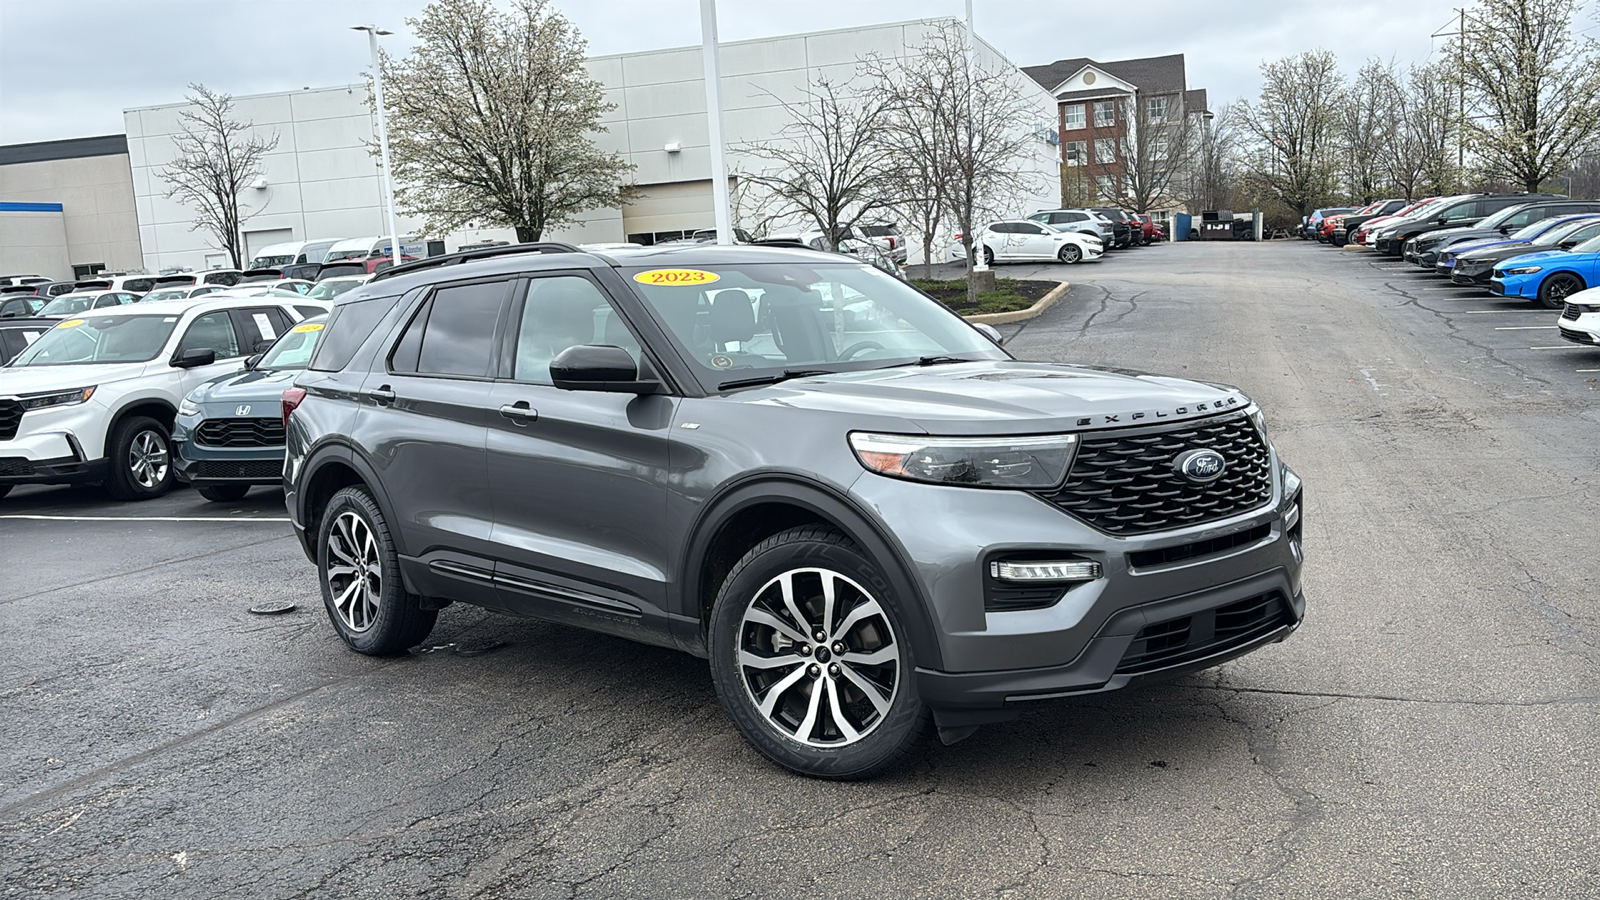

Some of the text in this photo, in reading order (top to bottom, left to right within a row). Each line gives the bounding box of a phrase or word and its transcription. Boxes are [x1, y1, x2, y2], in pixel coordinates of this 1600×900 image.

[651, 272, 706, 283] 2023
[1076, 397, 1237, 427] EXPLORER
[1196, 457, 1219, 475] Ford
